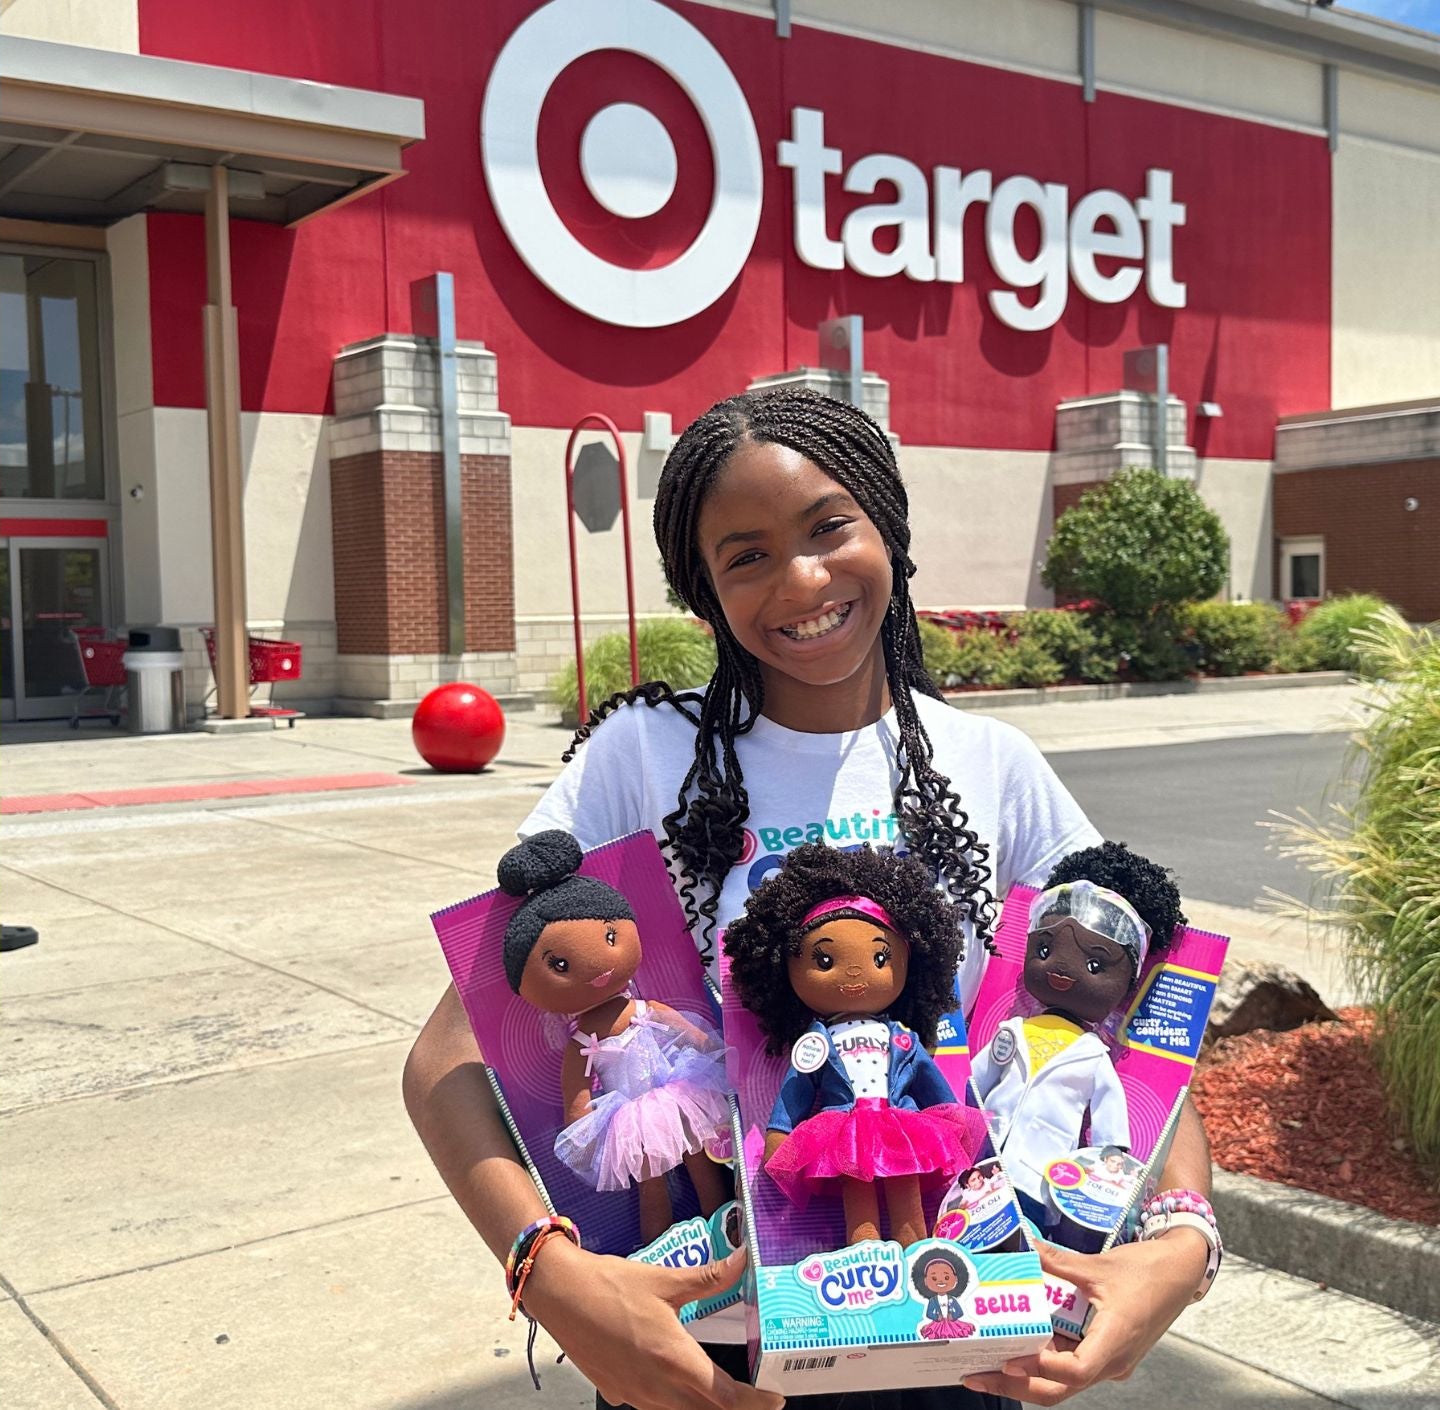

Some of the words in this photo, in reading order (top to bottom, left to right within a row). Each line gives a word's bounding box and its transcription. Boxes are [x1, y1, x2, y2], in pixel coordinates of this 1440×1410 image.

[777, 107, 1186, 331] target
[758, 809, 900, 852] Beautif
[1171, 986, 1192, 995] SMART
[1174, 978, 1206, 992] BEAUTIFUL
[1152, 996, 1176, 1007] MATTER
[1167, 992, 1192, 1004] STRONG
[835, 1037, 889, 1053] CURLY
[641, 1224, 703, 1263] Beautiful
[656, 1238, 710, 1268] urly
[823, 1247, 896, 1273] Beautiful
[821, 1264, 898, 1306] Curly
[847, 1289, 875, 1305] me
[974, 1293, 1031, 1315] Bella
[782, 1316, 824, 1328] WARNING:
